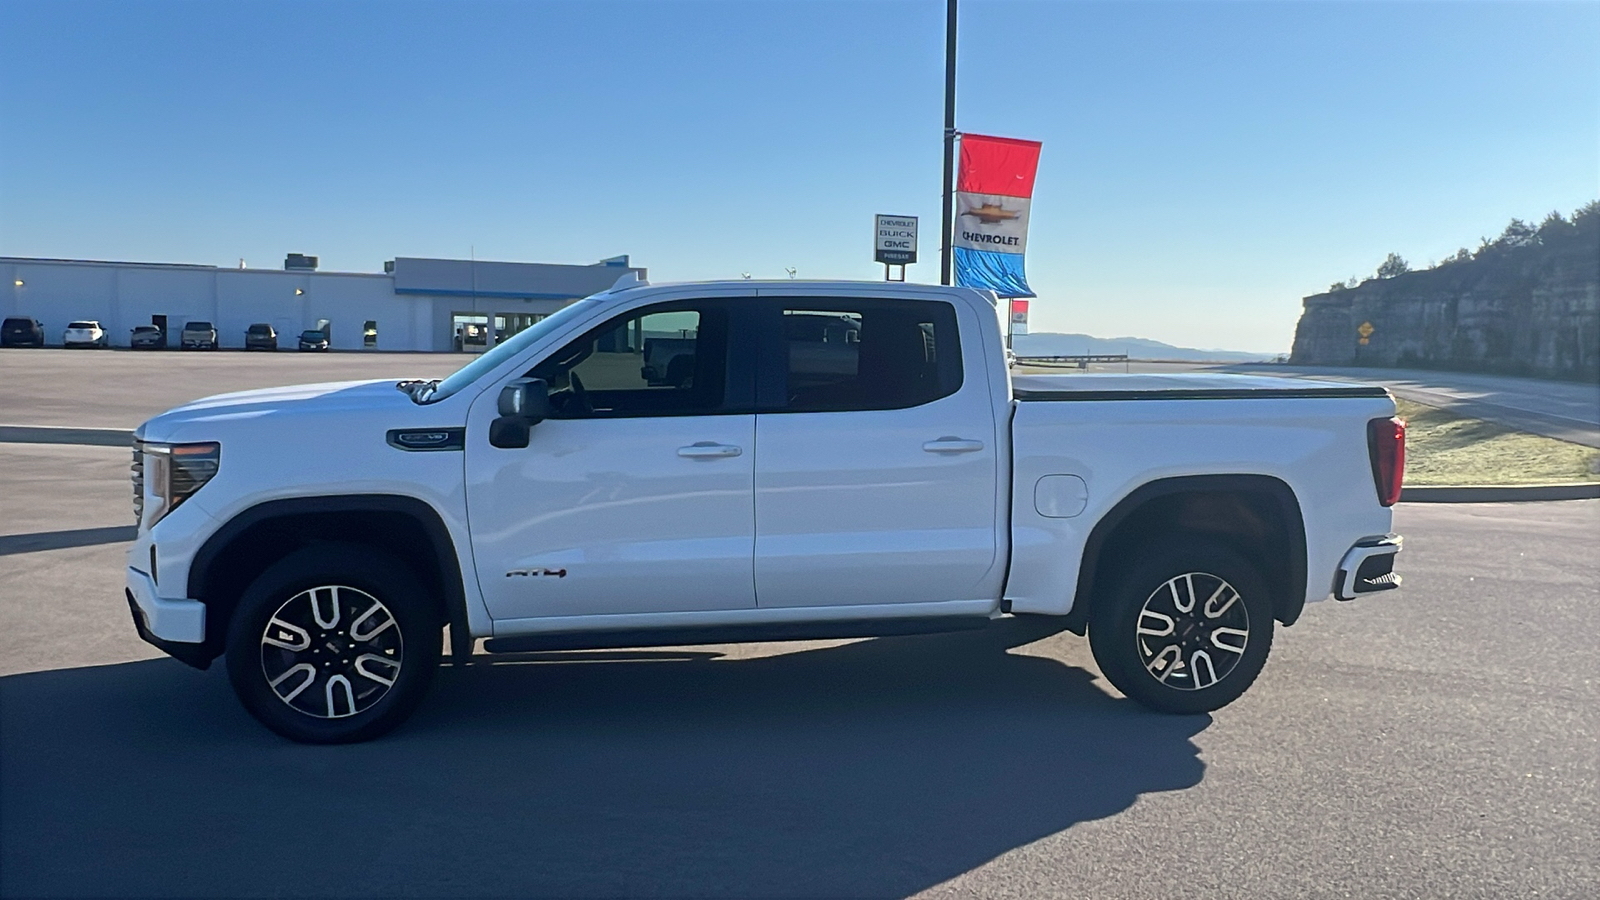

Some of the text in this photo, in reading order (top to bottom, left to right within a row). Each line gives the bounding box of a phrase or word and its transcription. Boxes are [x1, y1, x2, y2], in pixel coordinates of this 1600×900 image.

[880, 219, 914, 227] CHEVROLET
[879, 229, 915, 238] BUICK
[962, 231, 1019, 246] CHEVROLET
[884, 240, 910, 249] GMC
